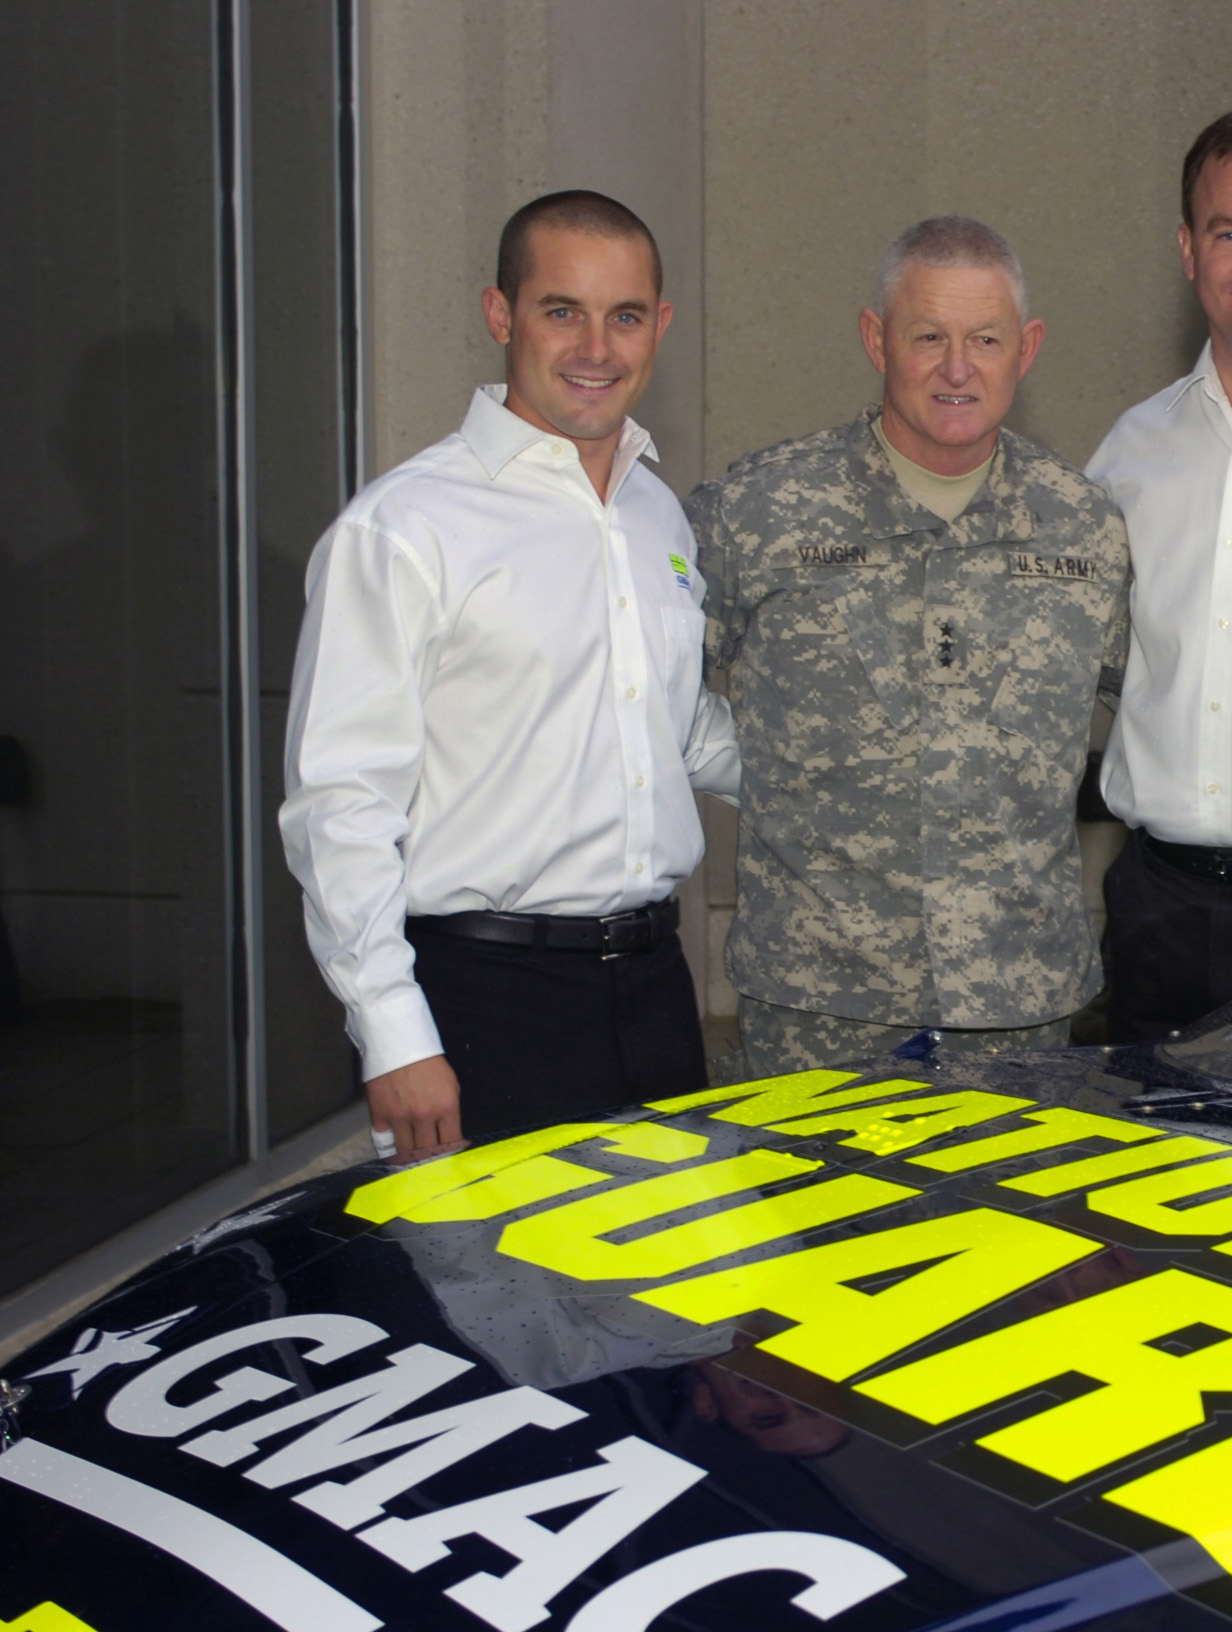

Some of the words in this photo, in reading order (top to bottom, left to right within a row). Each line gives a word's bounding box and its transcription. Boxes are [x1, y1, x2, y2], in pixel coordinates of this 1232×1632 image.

[798, 545, 867, 564] VAUGHN
[1018, 555, 1048, 575] U.S.
[1054, 557, 1097, 579] ARMY
[105, 1313, 908, 1632] GMAC
